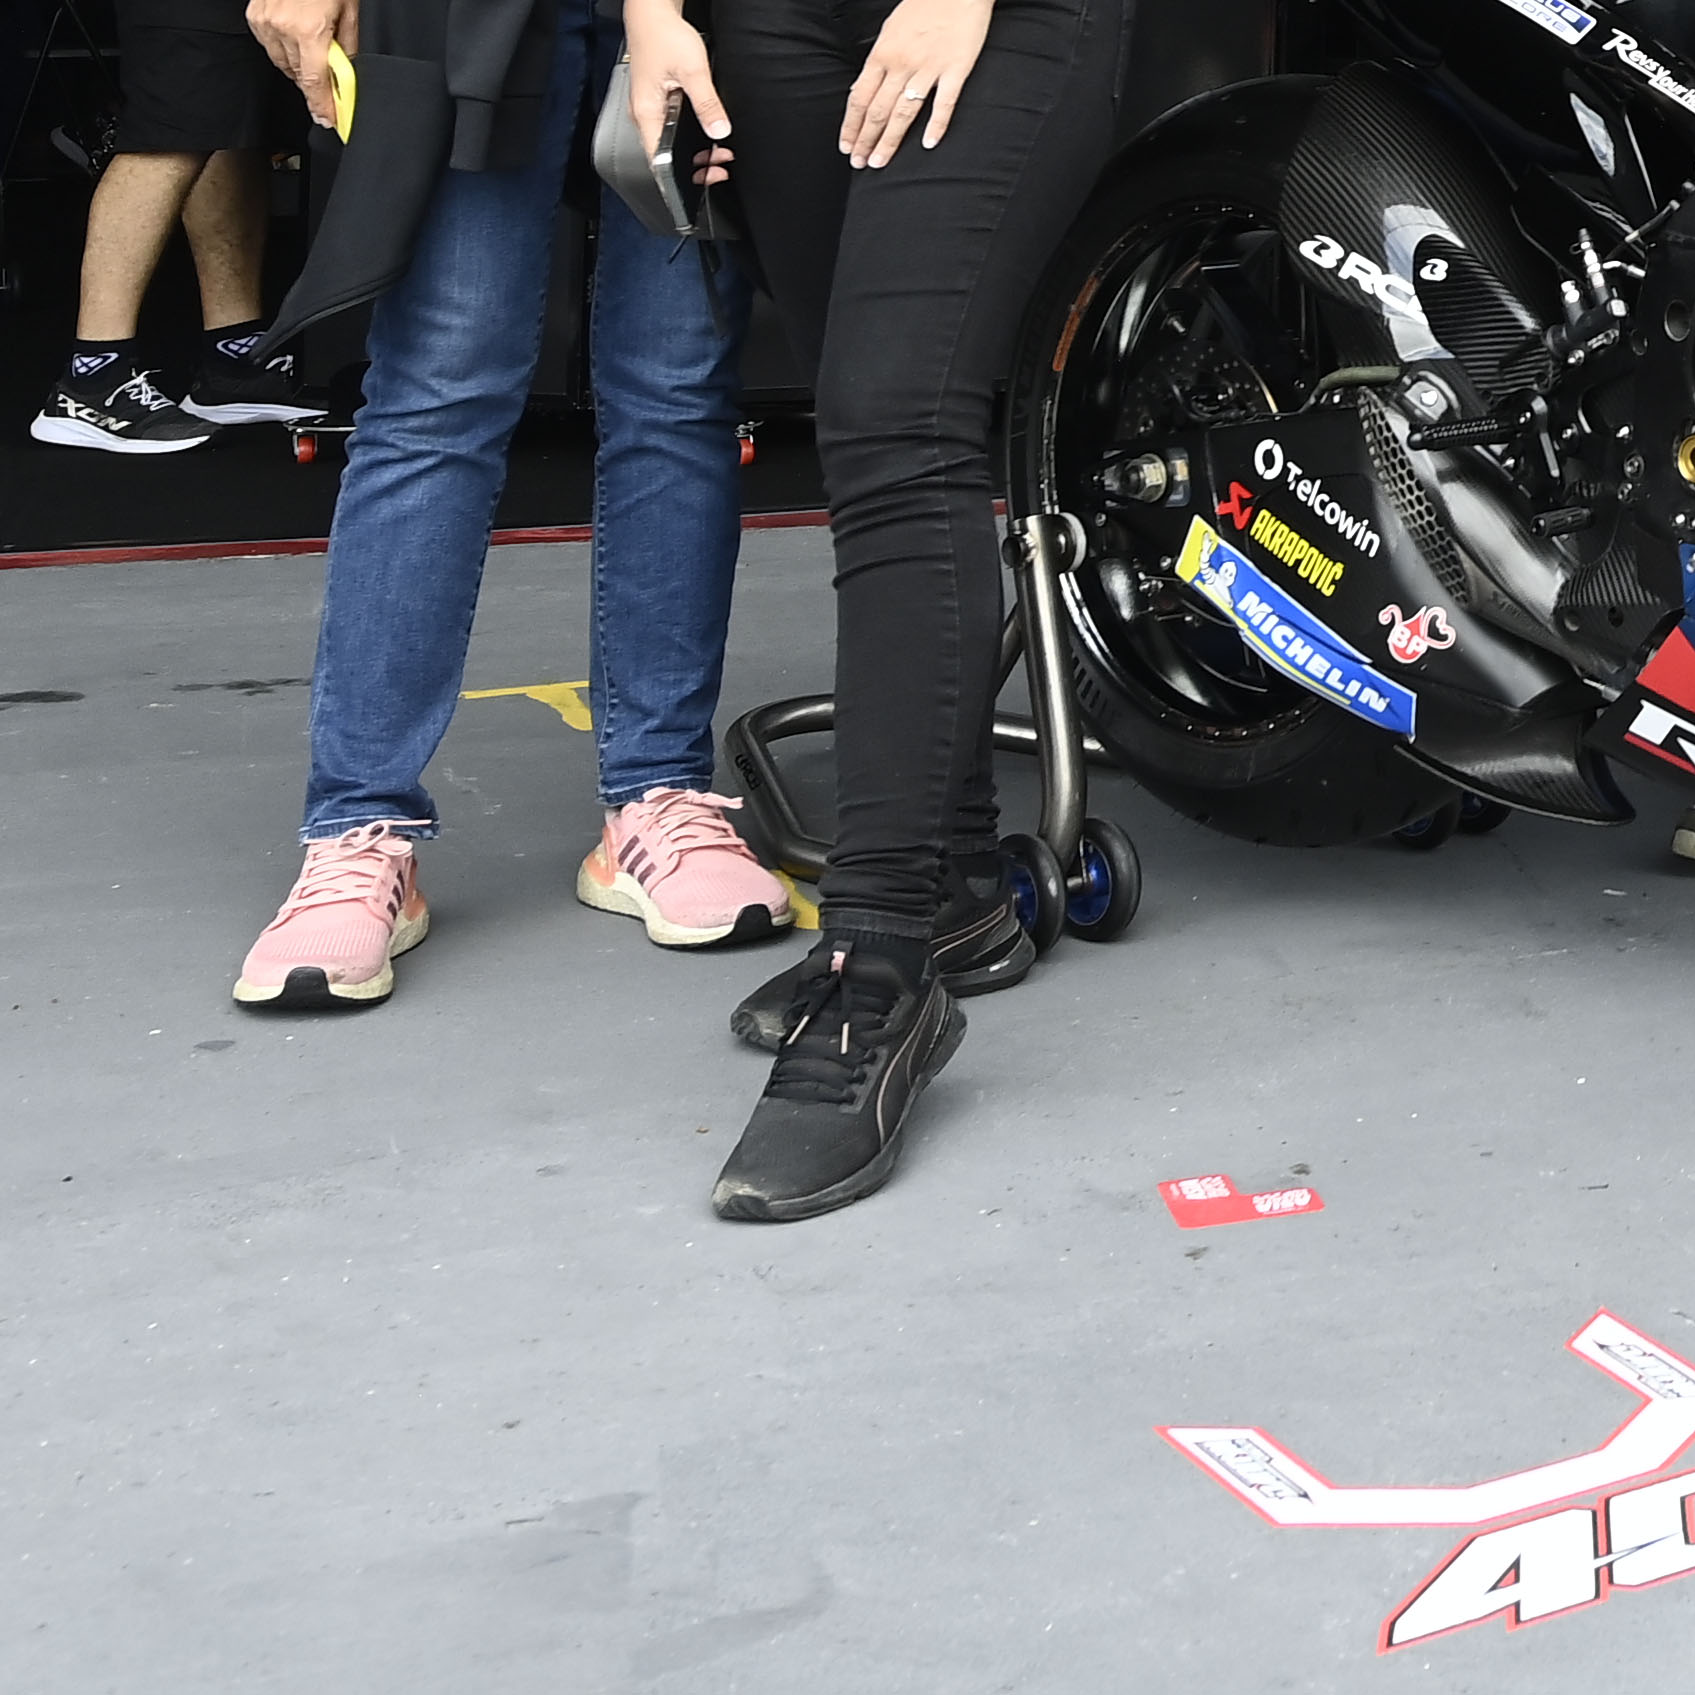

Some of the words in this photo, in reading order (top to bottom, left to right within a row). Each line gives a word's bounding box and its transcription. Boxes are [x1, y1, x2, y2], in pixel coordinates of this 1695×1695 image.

[1602, 28, 1661, 77] Revs
[1653, 66, 1692, 101] Your
[1284, 460, 1382, 559] Telcowin
[1236, 589, 1390, 716] MICHELIN
[1393, 624, 1422, 656] BP
